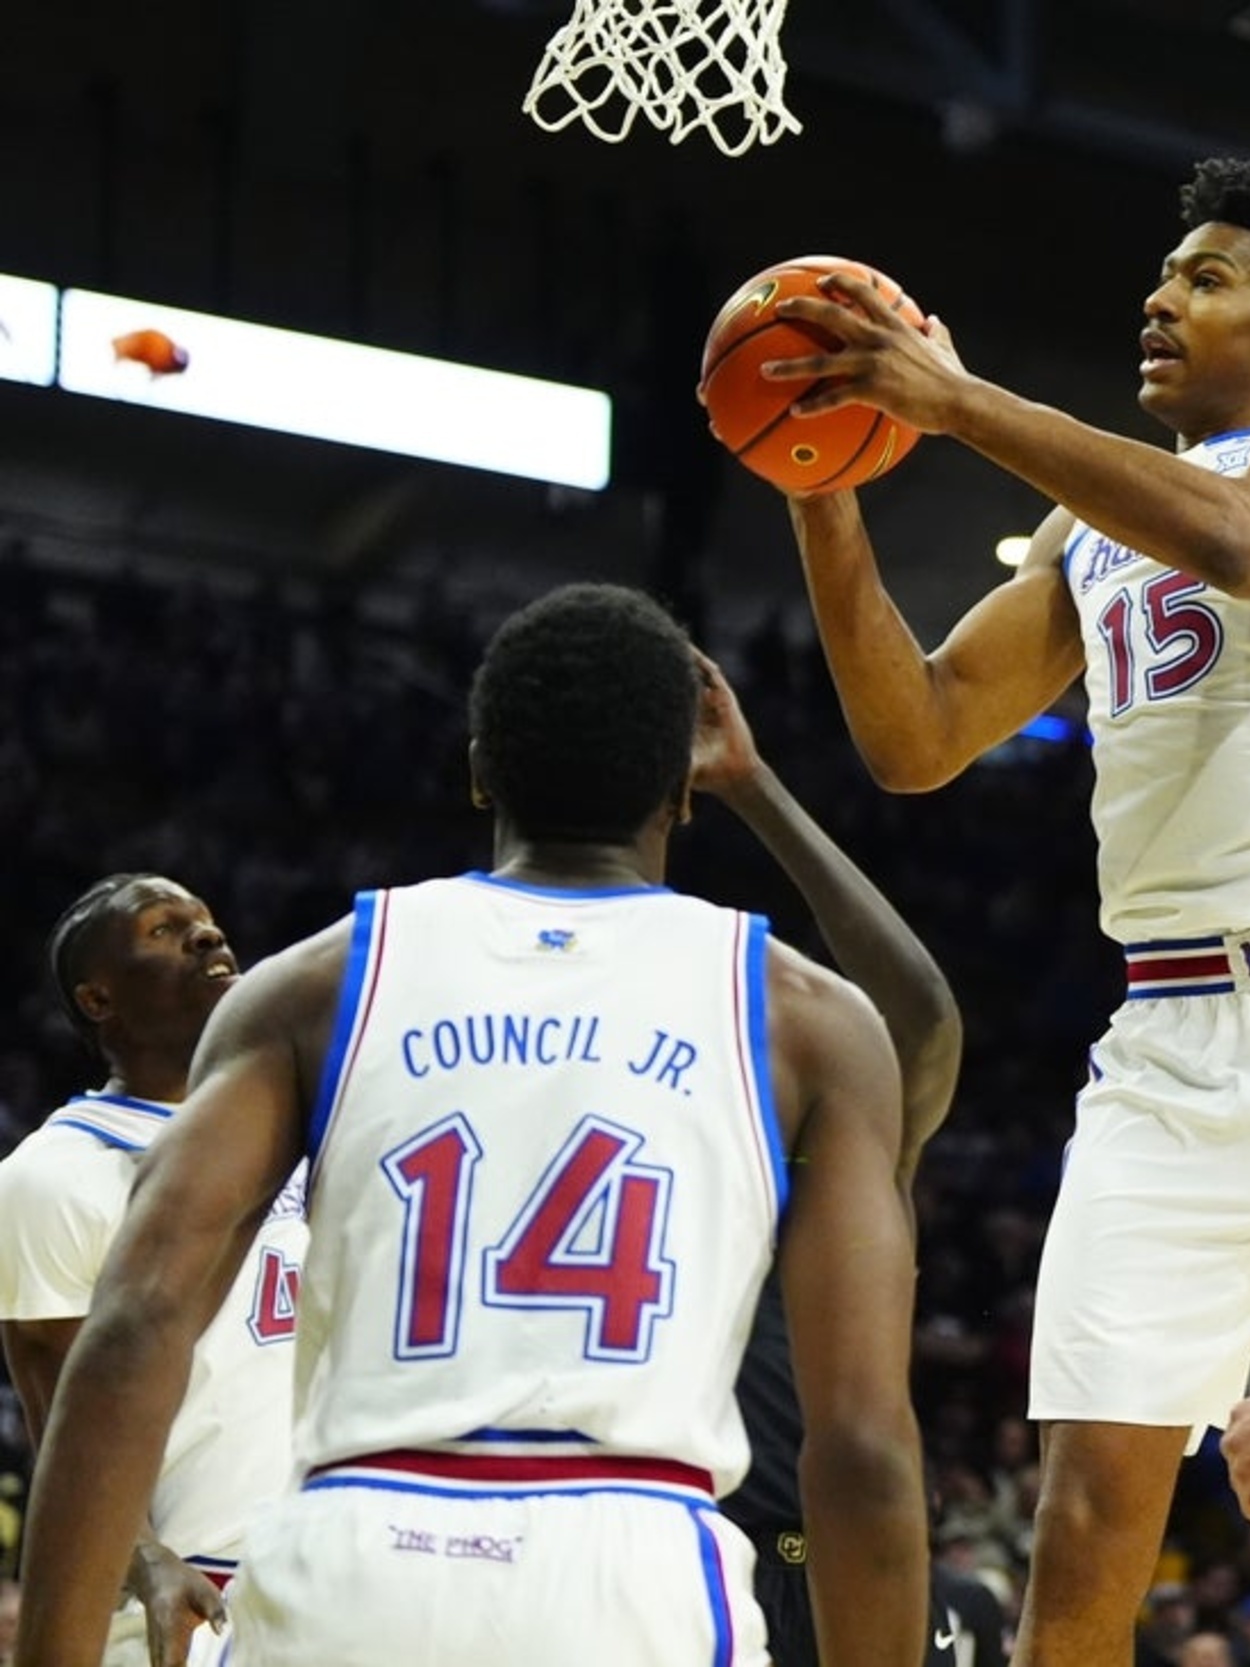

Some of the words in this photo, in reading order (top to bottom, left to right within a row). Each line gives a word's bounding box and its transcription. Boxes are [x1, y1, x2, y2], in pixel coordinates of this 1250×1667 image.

[1097, 568, 1224, 718] 15
[402, 1014, 601, 1078] COUNCIL
[628, 1030, 698, 1096] JR.
[380, 1111, 676, 1363] 14
